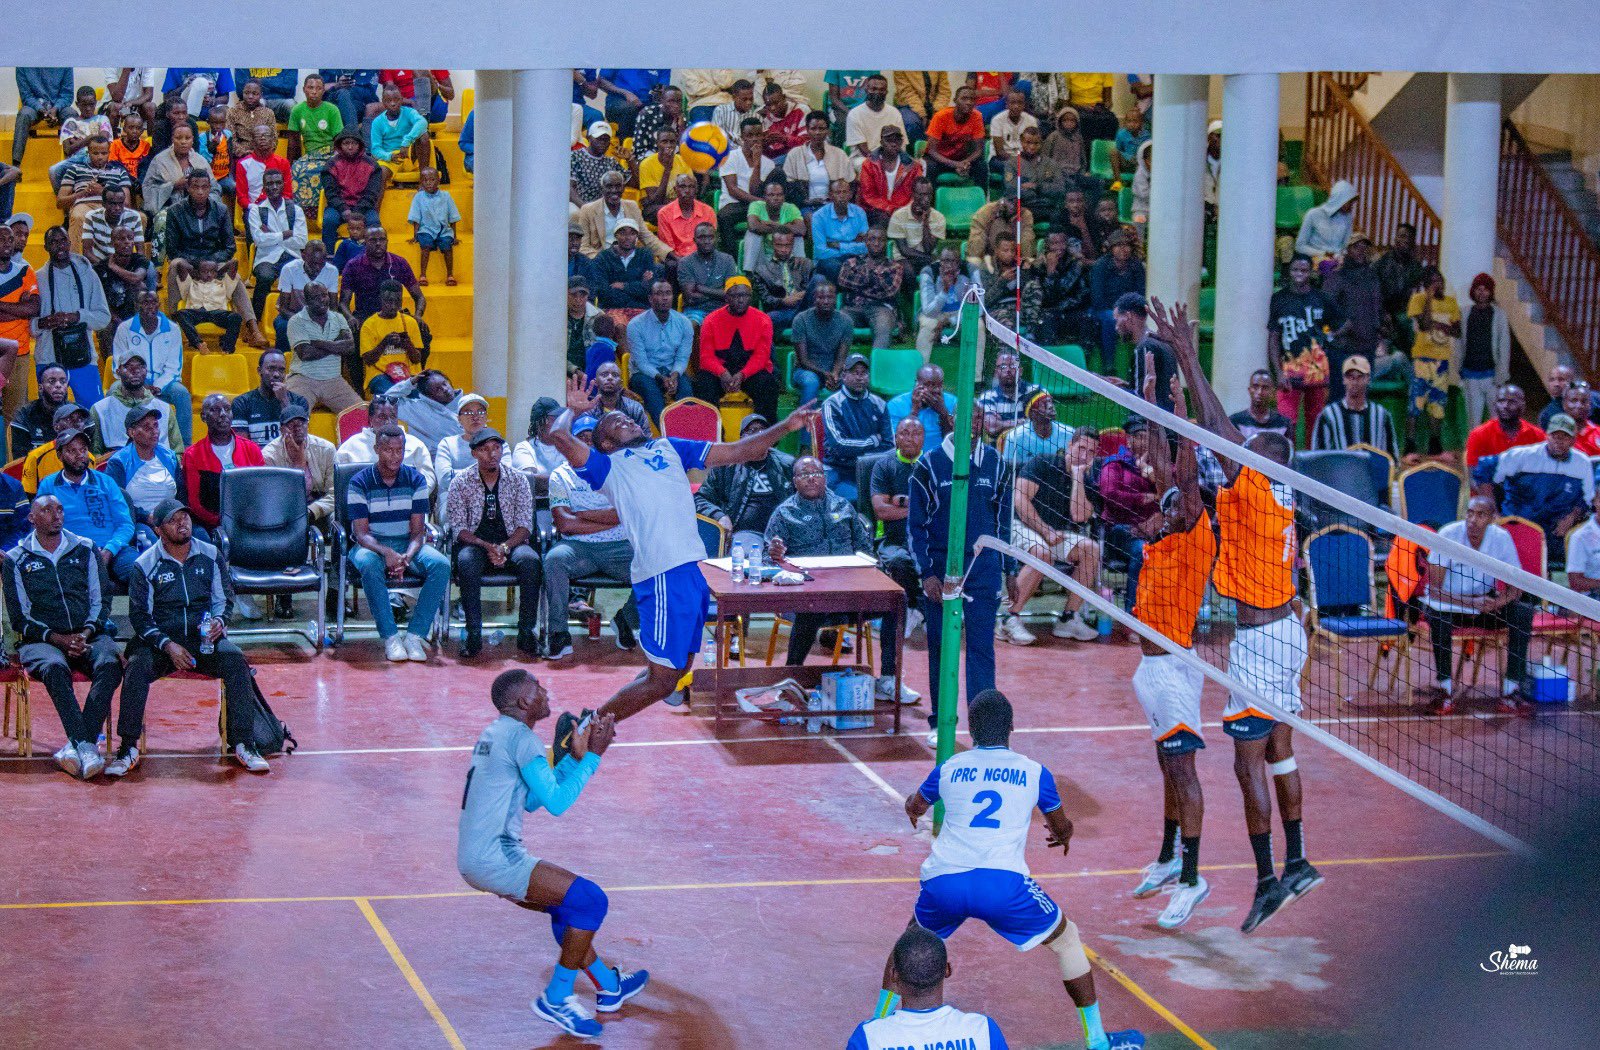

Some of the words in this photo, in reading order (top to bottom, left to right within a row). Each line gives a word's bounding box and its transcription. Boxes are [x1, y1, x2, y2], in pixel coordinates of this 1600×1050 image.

[264, 424, 280, 440] 18
[950, 767, 978, 783] IPRC
[983, 767, 1027, 787] NGOMA
[969, 789, 1003, 829] 2
